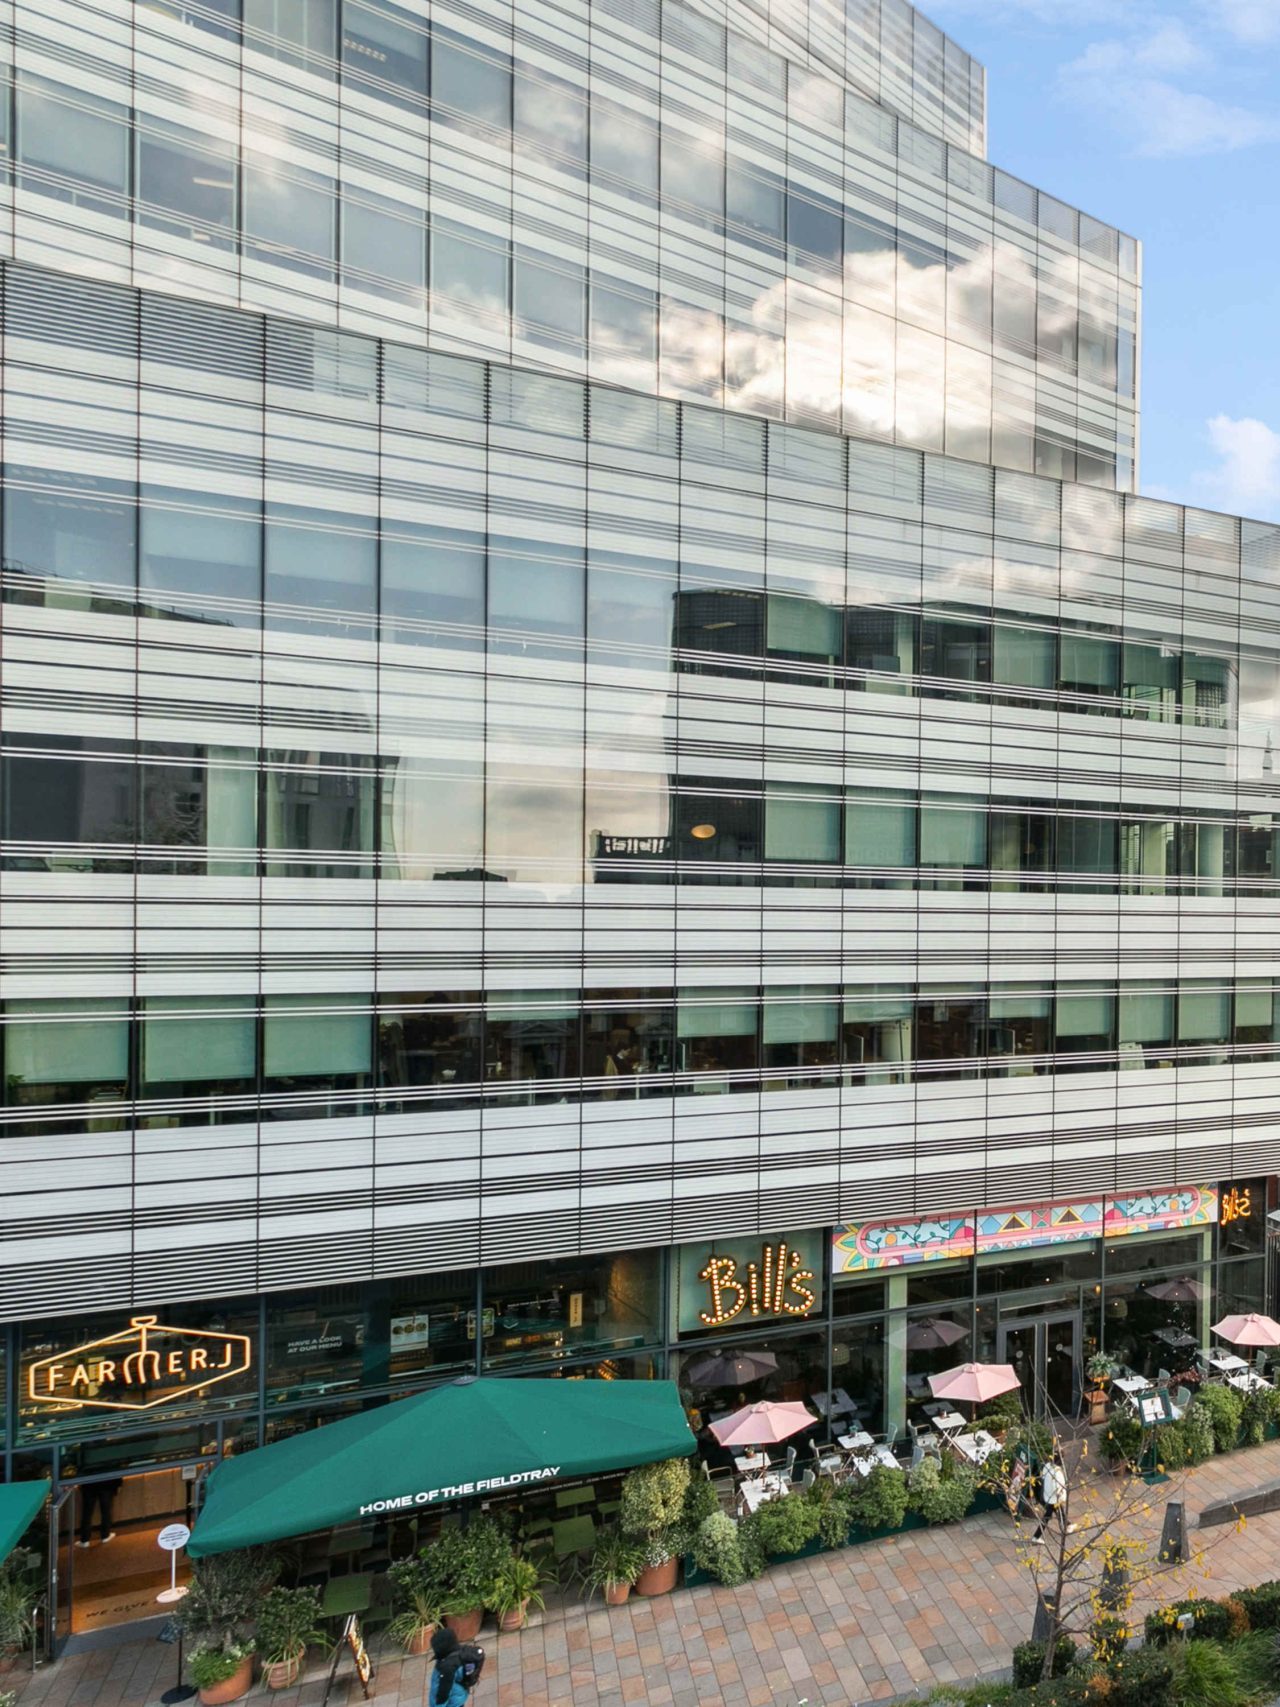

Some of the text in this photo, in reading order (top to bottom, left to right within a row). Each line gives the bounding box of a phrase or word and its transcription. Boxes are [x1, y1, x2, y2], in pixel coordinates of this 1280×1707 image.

[698, 1241, 816, 1326] Bill's
[287, 1340, 310, 1348] HAVE
[319, 1336, 342, 1344] LOOK
[318, 1341, 343, 1350] MENU
[48, 1343, 232, 1392] FARMER.J
[359, 1495, 413, 1516] HOME
[415, 1488, 440, 1505] OF
[441, 1482, 475, 1499] THE
[476, 1466, 561, 1492] FIELDTRAY
